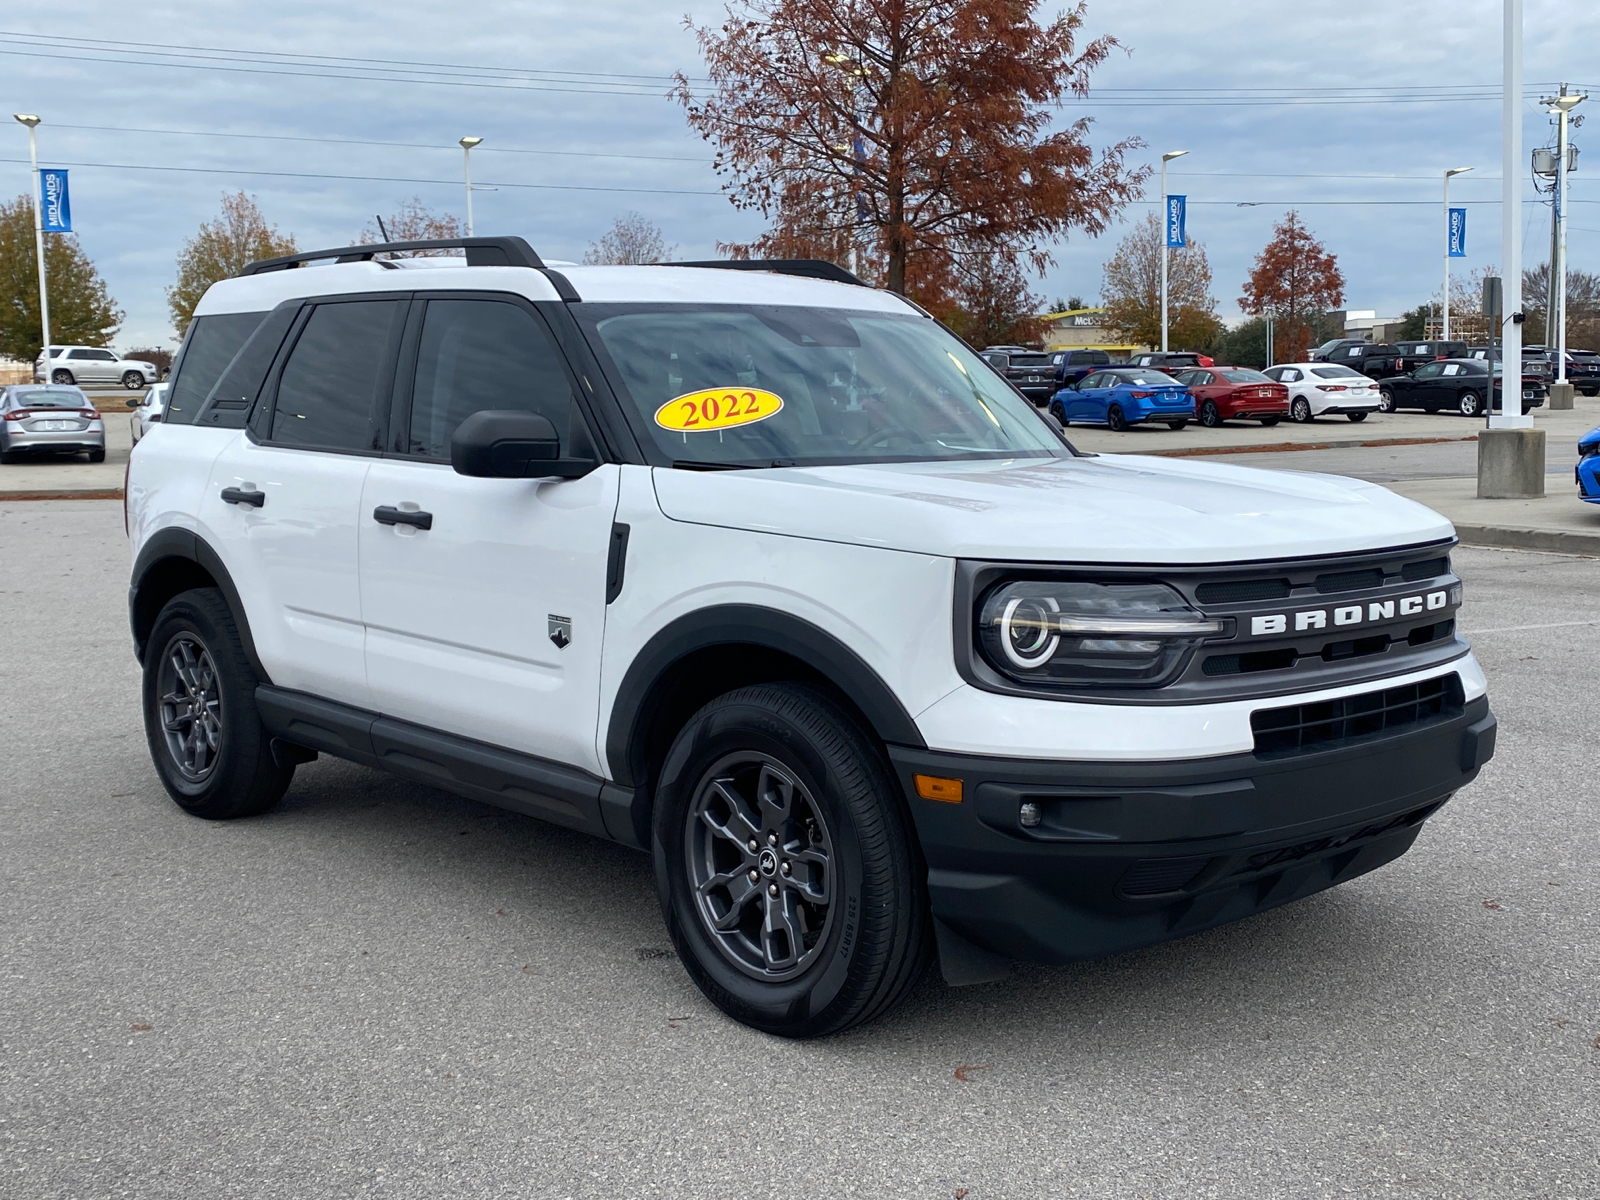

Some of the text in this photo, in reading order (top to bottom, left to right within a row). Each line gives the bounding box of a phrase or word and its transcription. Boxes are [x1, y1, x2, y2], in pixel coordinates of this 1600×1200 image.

[45, 173, 59, 227] MIDLANDS
[1170, 199, 1178, 243] MIDLANDS
[681, 392, 760, 427] 2022
[1251, 590, 1447, 636] BRONCO
[840, 895, 857, 959] 225/65R17
